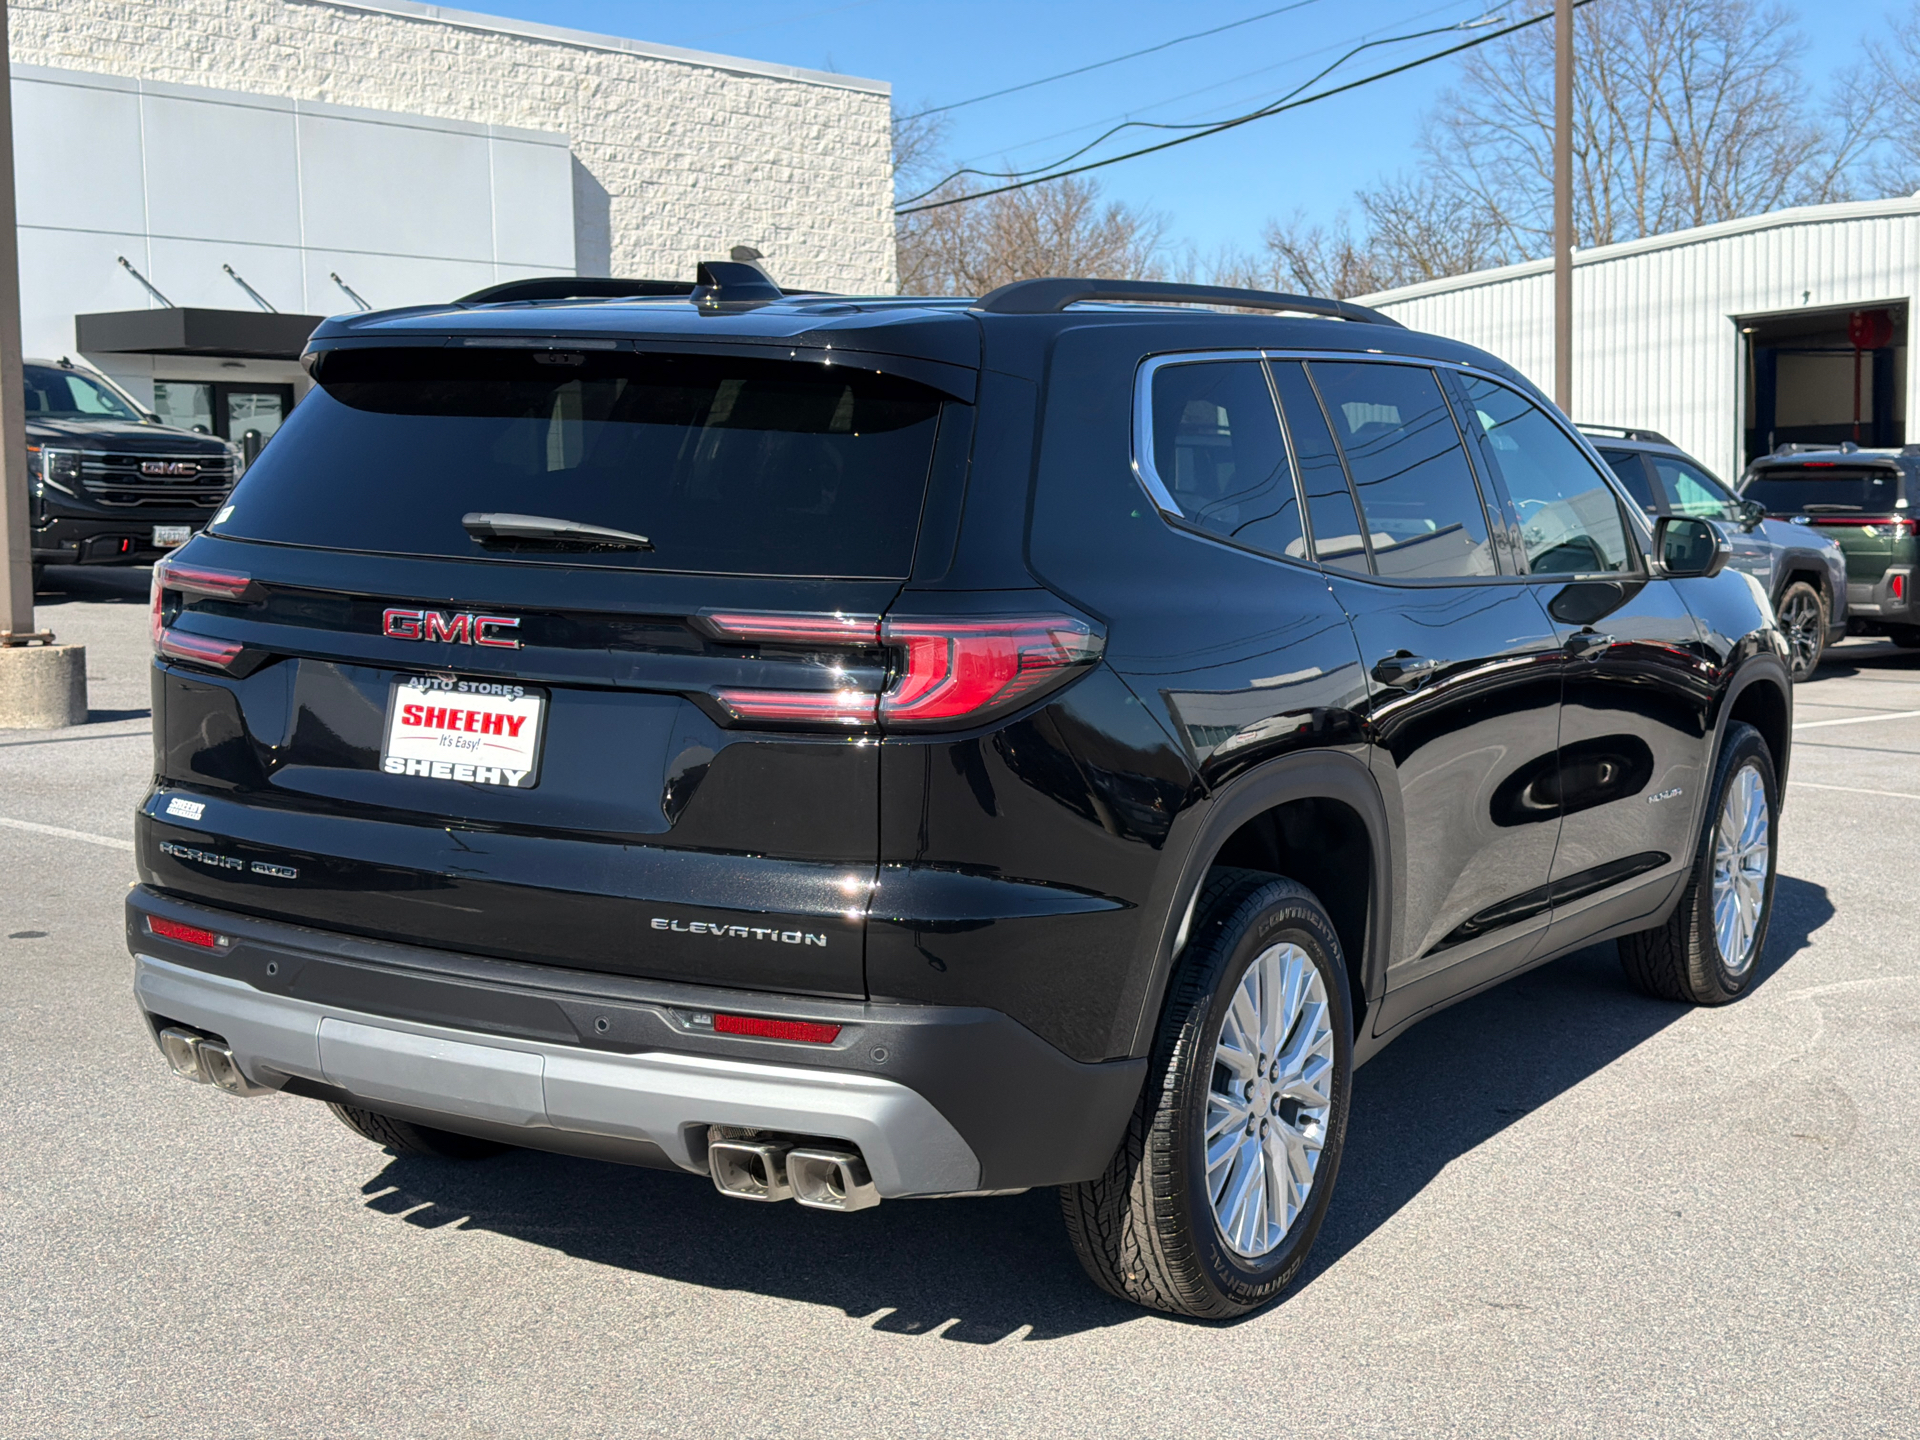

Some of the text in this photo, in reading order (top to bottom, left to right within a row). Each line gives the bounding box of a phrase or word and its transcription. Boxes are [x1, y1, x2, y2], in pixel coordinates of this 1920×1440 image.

[141, 461, 197, 475] GMC
[382, 607, 521, 649] GMC
[409, 677, 524, 698] AUTO STORES
[401, 703, 527, 738] SHEEHY
[439, 734, 481, 753] It's Easy!
[384, 757, 527, 786] SHEEHY
[159, 841, 298, 879] ACADIA AWD
[650, 918, 827, 947] ELEVATION
[1210, 1243, 1301, 1298] CONTINENTAL
